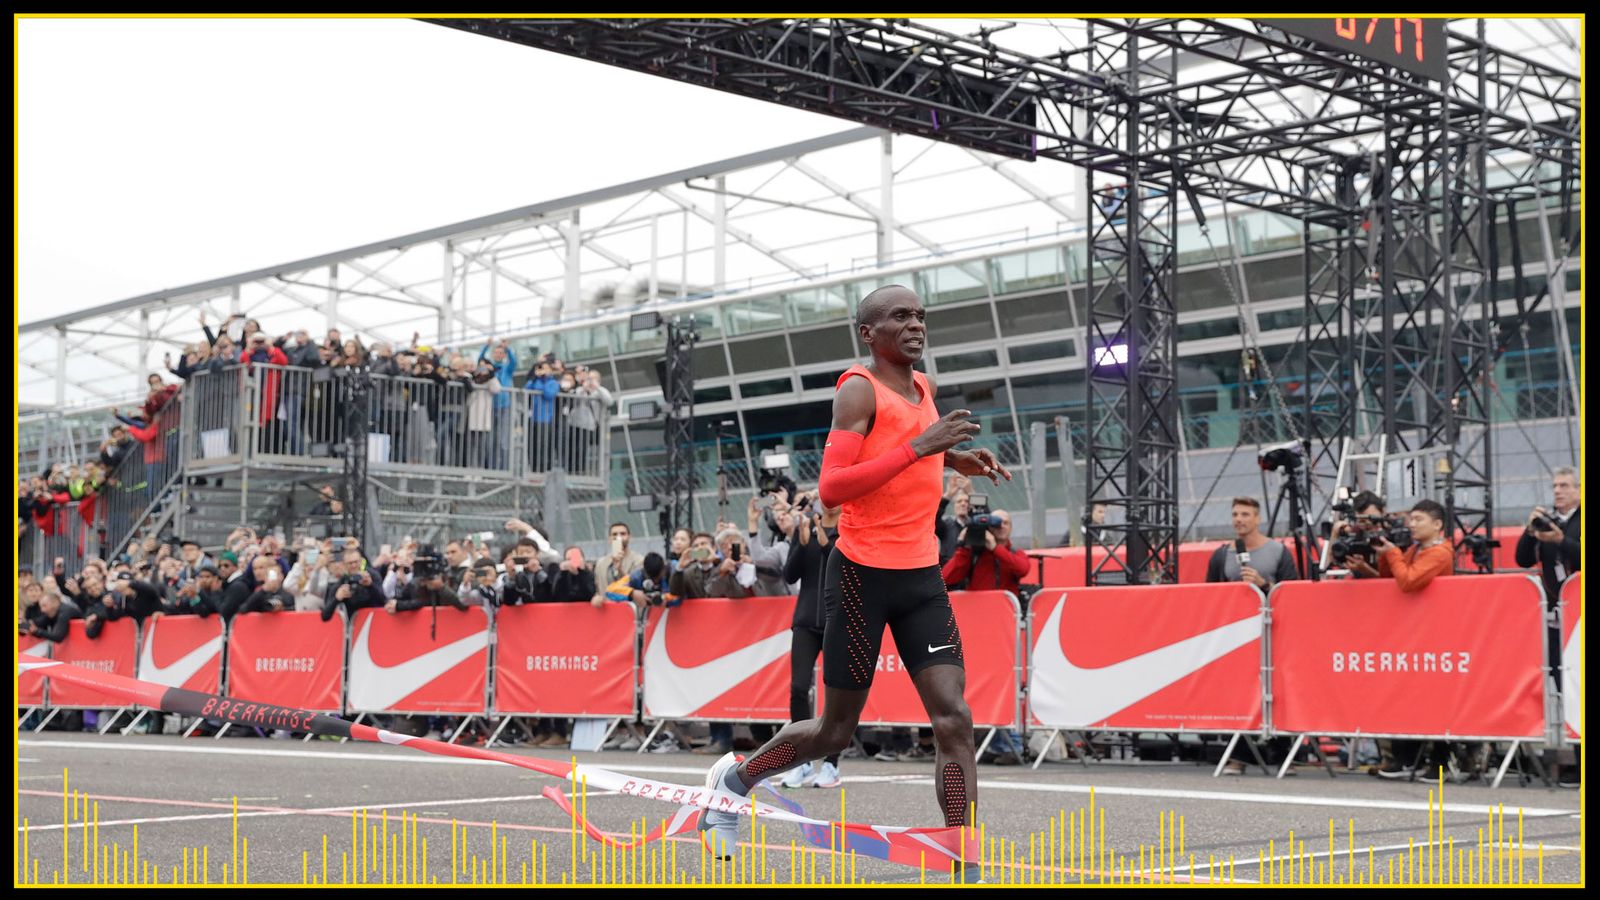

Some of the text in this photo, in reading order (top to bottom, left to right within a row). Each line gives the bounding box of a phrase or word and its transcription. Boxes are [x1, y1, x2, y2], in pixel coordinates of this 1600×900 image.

[255, 657, 315, 673] BREAKING2
[526, 655, 599, 672] BREAKING2
[1332, 652, 1471, 673] BREAKING2
[201, 698, 318, 730] BREAKING2
